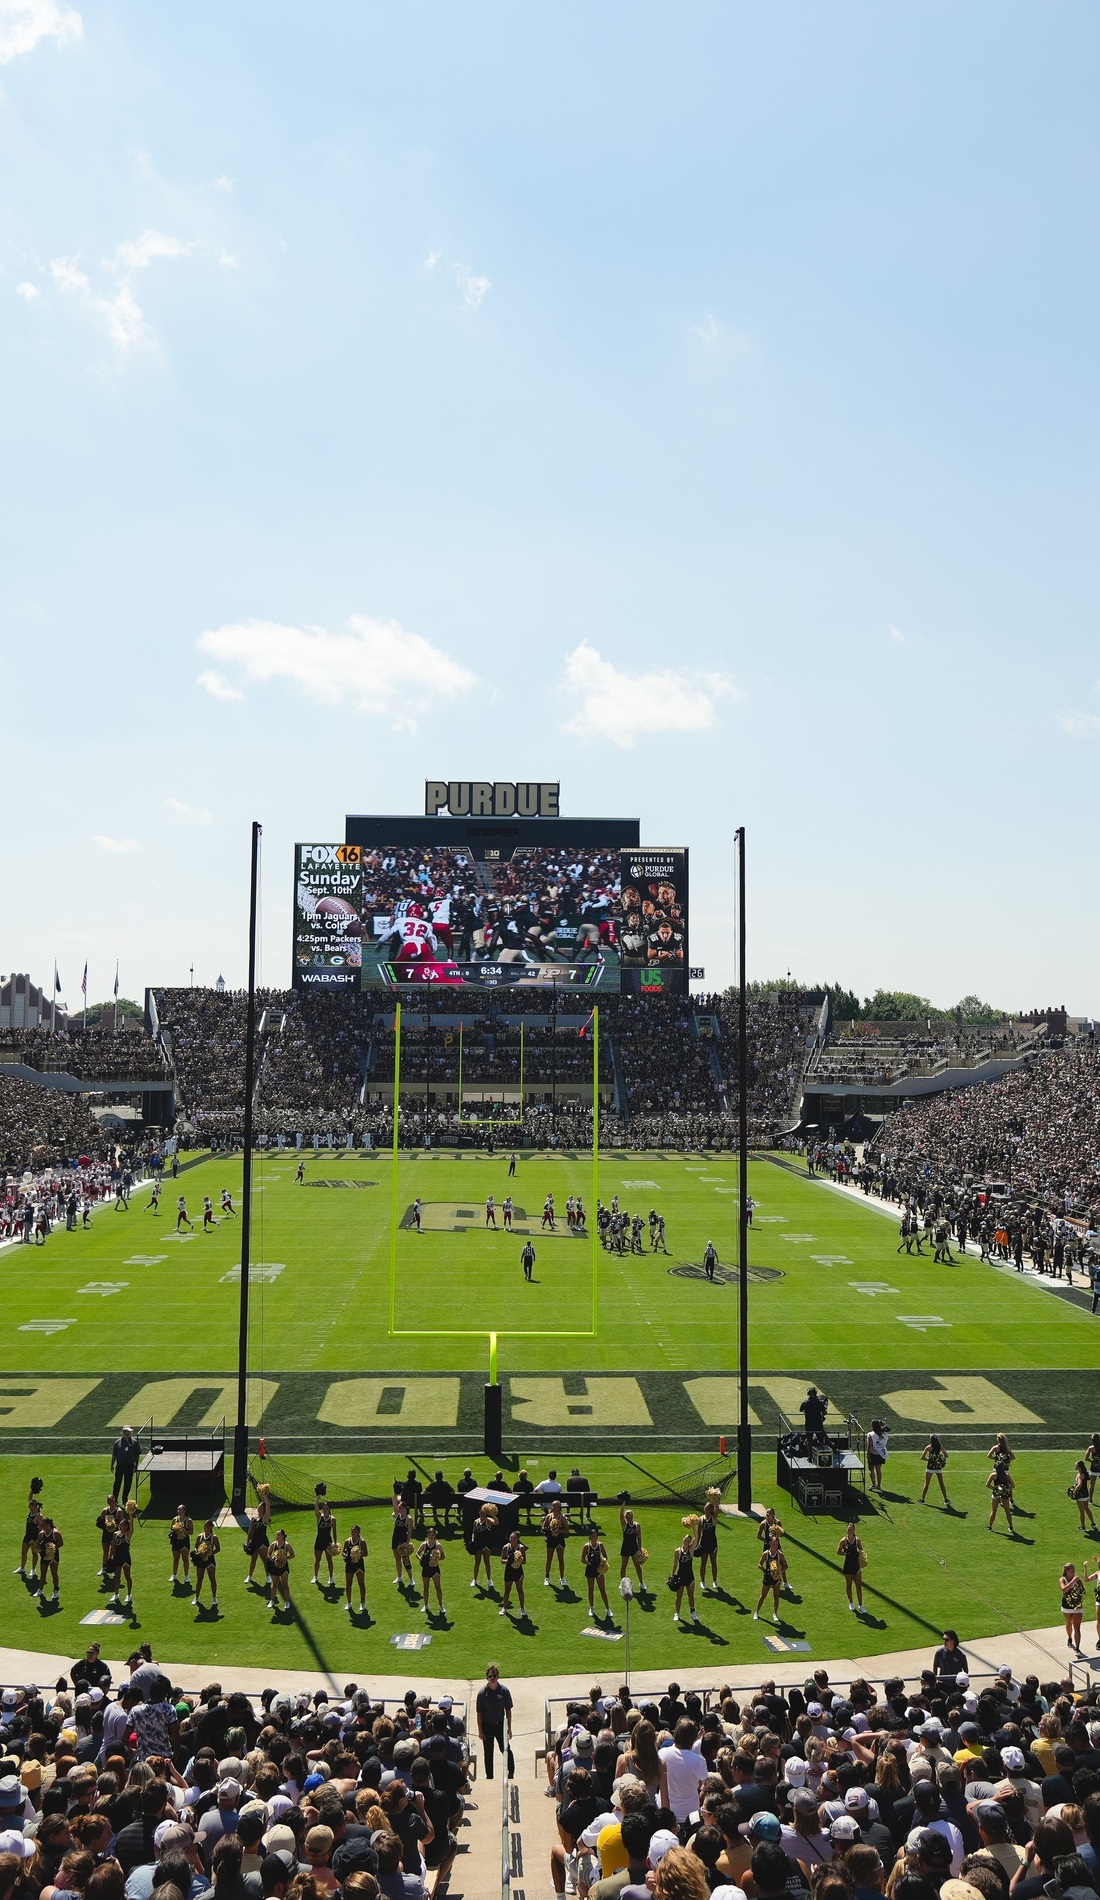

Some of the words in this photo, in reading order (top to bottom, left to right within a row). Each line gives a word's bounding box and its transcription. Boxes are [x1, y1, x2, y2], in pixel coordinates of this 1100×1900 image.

[425, 781, 560, 817] PURDUE
[301, 845, 340, 863] FOX
[340, 847, 359, 862] 16
[300, 871, 360, 889] Sunday
[307, 886, 330, 895] Sept.
[332, 886, 352, 895] 10th
[302, 912, 321, 922] 1pm
[323, 912, 358, 922] Jaguars
[325, 921, 348, 930] Colts
[403, 922, 428, 938] 32
[297, 935, 328, 944] 4:25pm
[330, 935, 361, 943] Packers
[325, 944, 347, 952] Bears
[405, 968, 415, 979] 7
[480, 966, 502, 975] 6:34
[568, 970, 577, 980] 7
[691, 968, 703, 978] 26
[301, 975, 354, 983] WABASH
